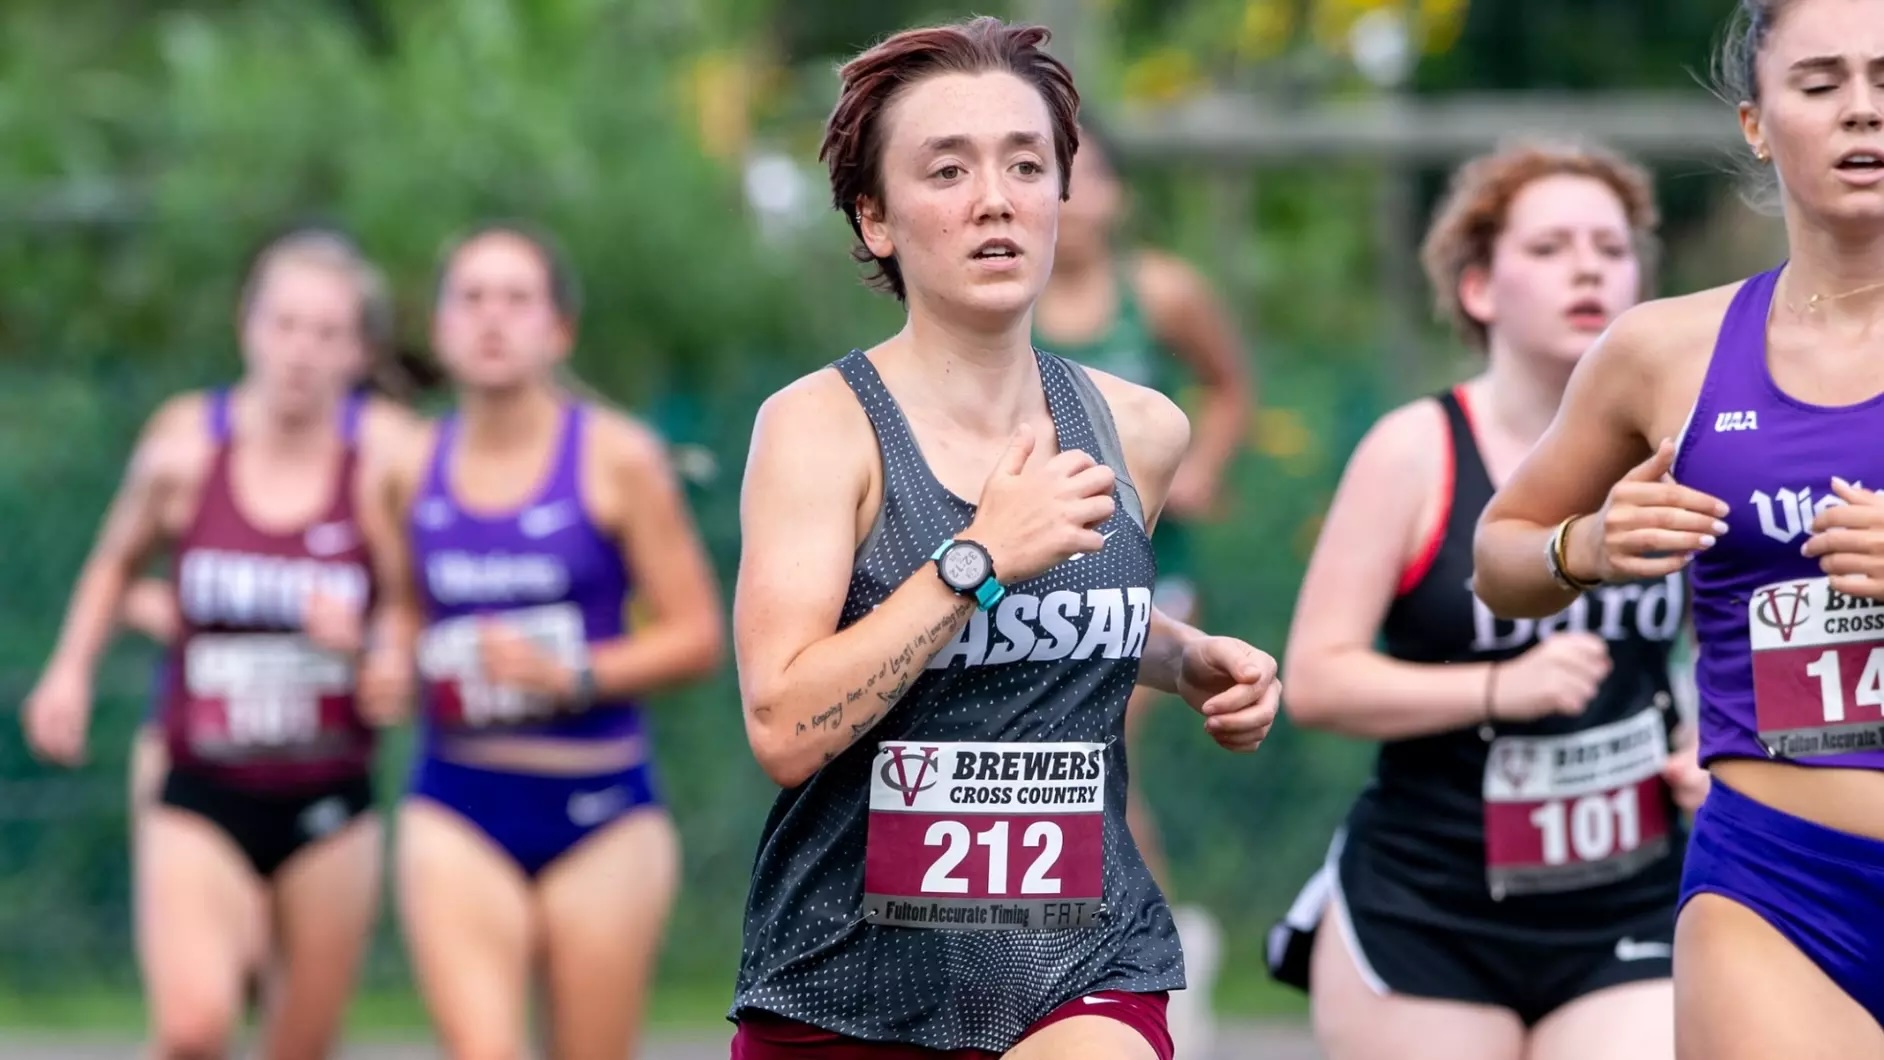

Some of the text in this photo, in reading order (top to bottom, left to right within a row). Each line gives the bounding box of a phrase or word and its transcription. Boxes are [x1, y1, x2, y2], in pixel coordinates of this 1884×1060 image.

[1715, 410, 1758, 432] UAA
[926, 587, 1151, 669] ASSAR
[1824, 614, 1884, 634] CROSS
[1806, 647, 1884, 722] 14
[952, 751, 1100, 780] BREWERS
[950, 785, 1098, 804] CROSS COUNTRY
[1529, 786, 1640, 866] 101
[921, 820, 1063, 894] 212
[885, 901, 1086, 927] Fulton Accurate Timing FAT
